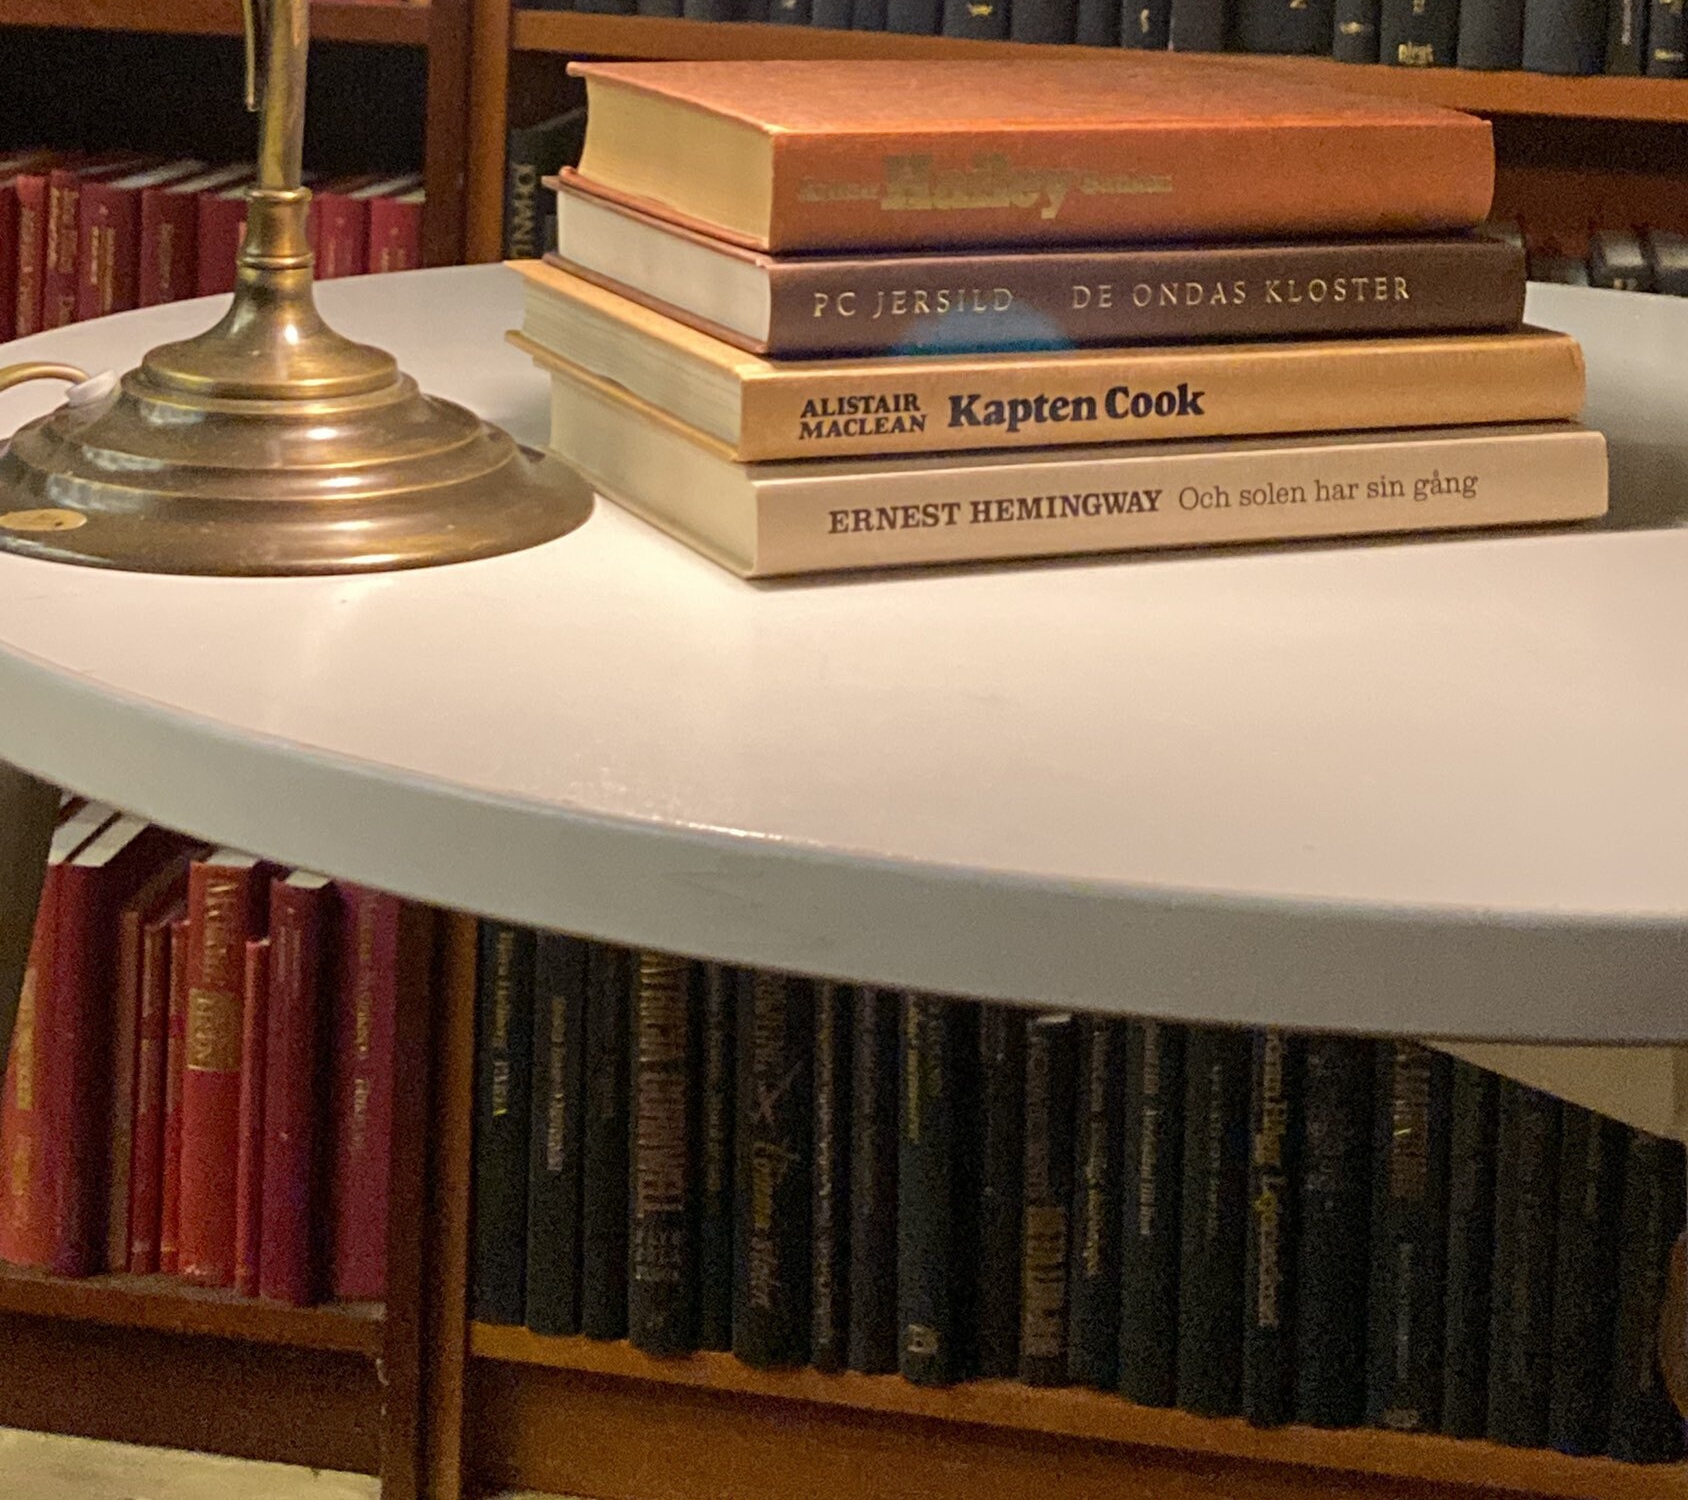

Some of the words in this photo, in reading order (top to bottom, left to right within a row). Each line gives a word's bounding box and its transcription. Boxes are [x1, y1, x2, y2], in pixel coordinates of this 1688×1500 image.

[813, 290, 857, 318] PC
[872, 288, 1015, 317] JERSILD
[1072, 282, 1113, 309] DE
[1132, 279, 1247, 309] ONDAS
[1264, 274, 1412, 305] KLOSTER
[798, 413, 927, 441] MACLEAN
[800, 392, 921, 419] ALISTAIR
[948, 391, 1099, 432] Kapten
[1103, 383, 1207, 419] Cook
[828, 502, 962, 535] ERNEST
[969, 489, 1164, 527] HEMINGWAY
[1177, 482, 1232, 512] Och
[1238, 477, 1308, 509] solen
[1314, 477, 1361, 505] har
[1366, 476, 1406, 501] sin
[1411, 469, 1479, 505] gång
